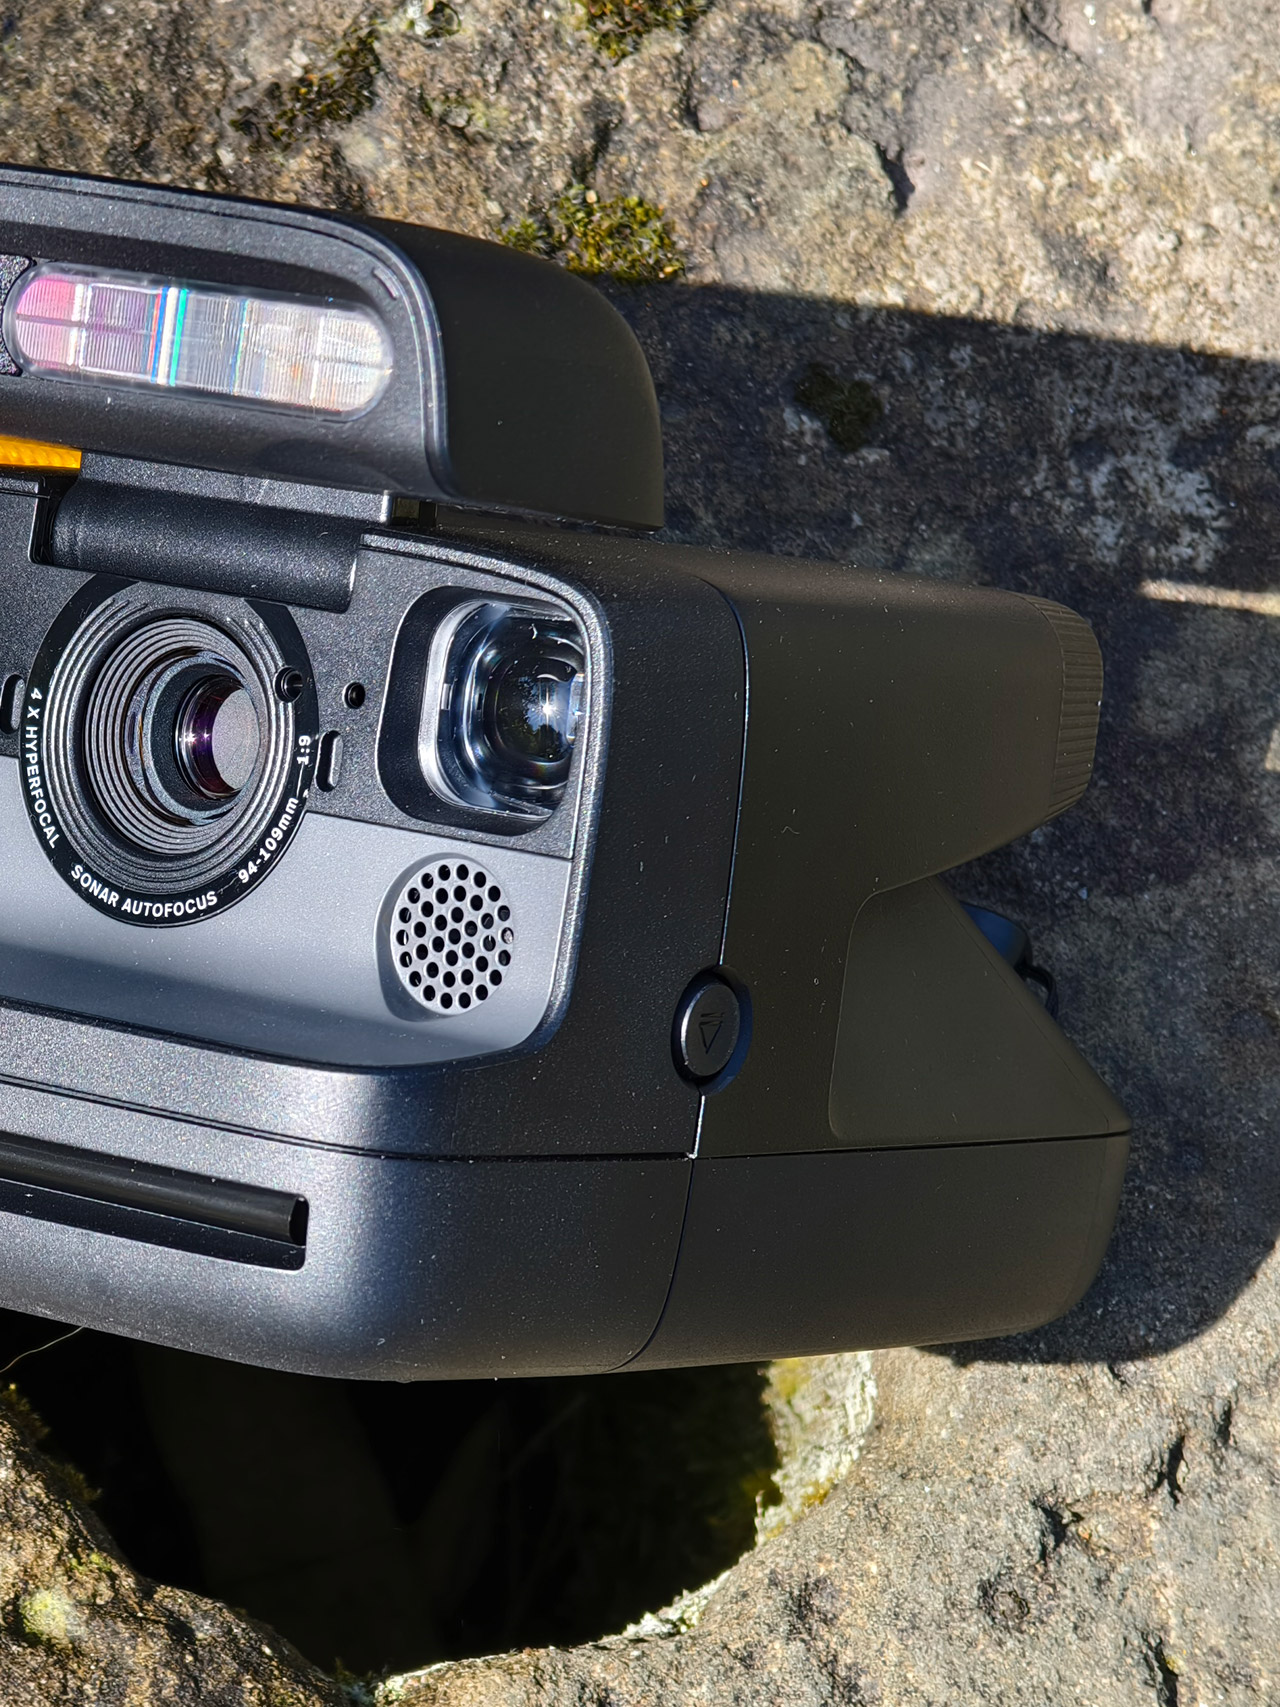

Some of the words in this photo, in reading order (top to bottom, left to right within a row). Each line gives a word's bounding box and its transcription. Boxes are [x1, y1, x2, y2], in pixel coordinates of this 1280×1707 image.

[27, 705, 40, 719] X
[30, 687, 43, 700] 4
[25, 726, 60, 849] HYPERFOCAL
[238, 797, 299, 883] 94-109mm
[296, 735, 311, 765] 1:9
[71, 864, 119, 907] SONAR
[121, 890, 218, 917] AUTOFOCUS
